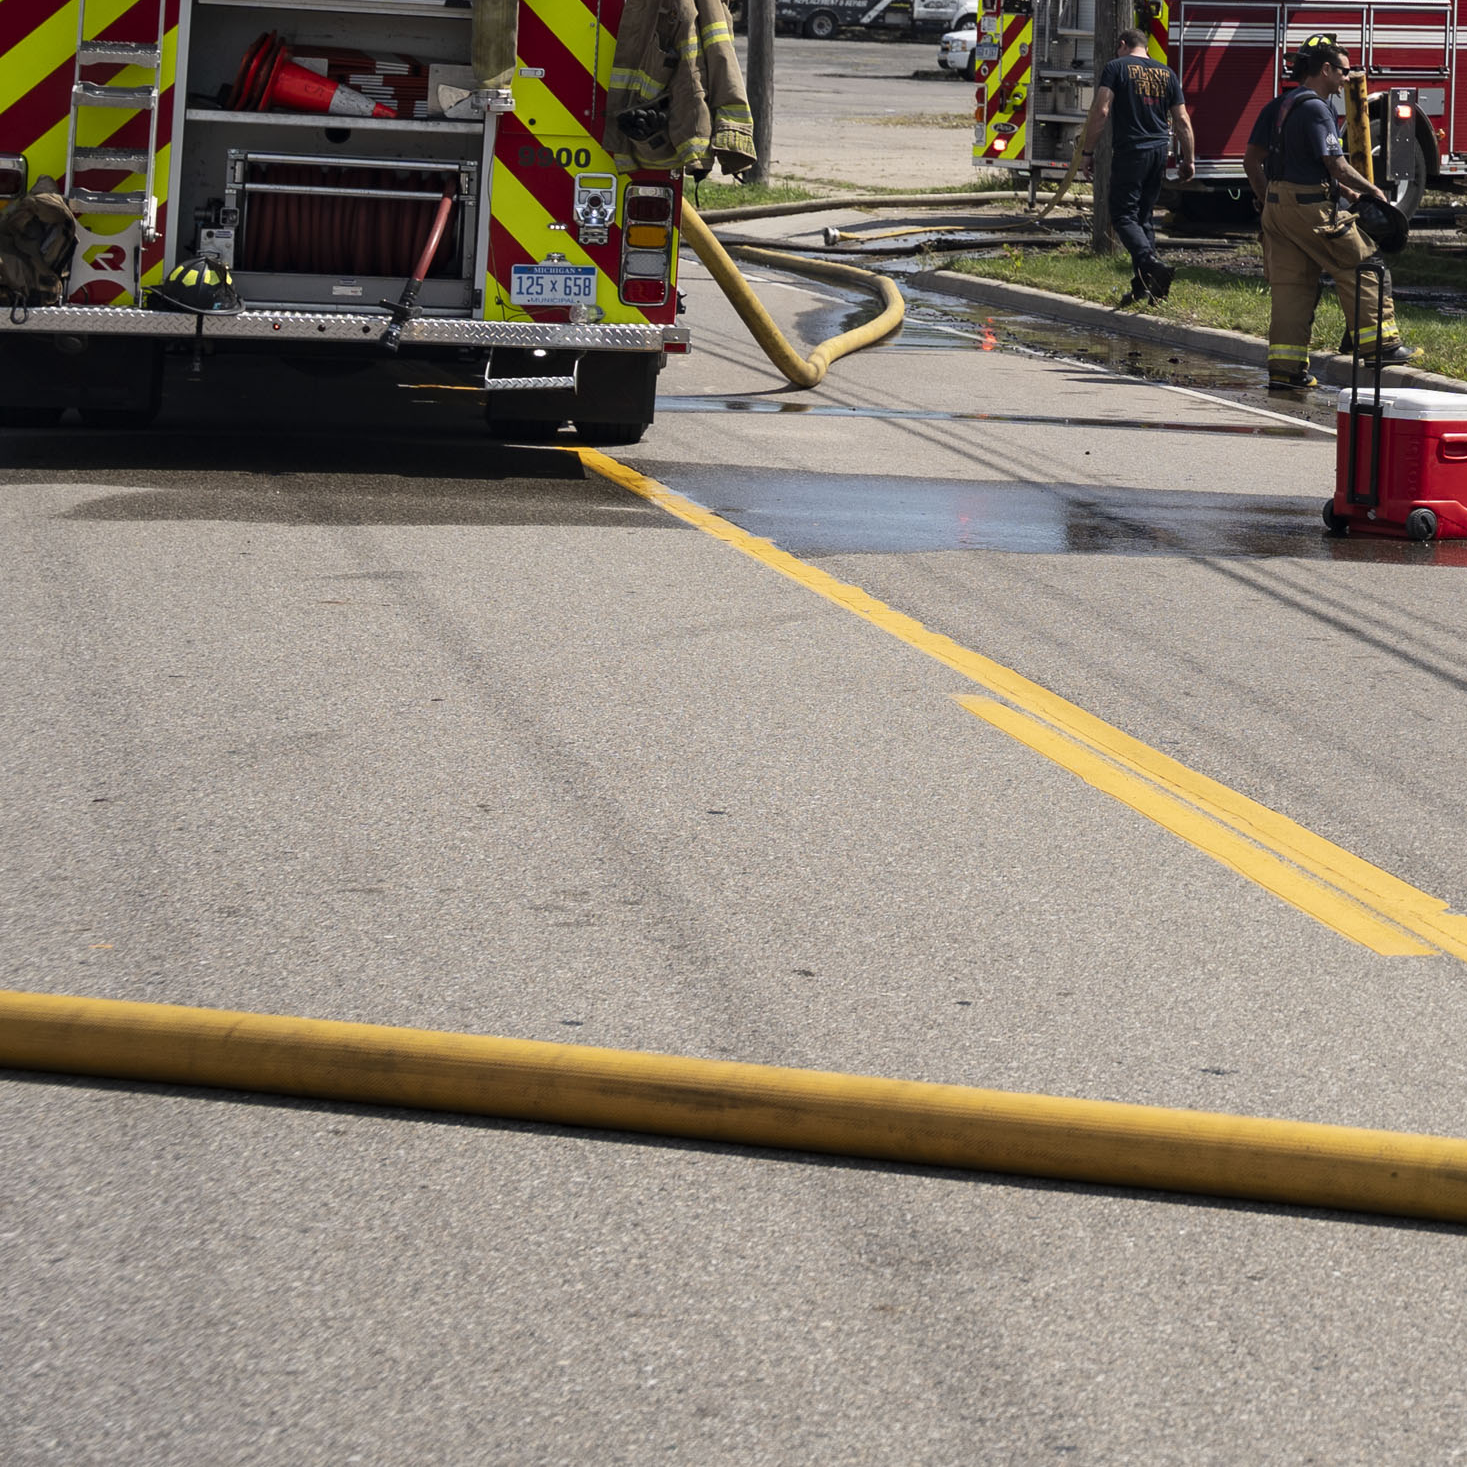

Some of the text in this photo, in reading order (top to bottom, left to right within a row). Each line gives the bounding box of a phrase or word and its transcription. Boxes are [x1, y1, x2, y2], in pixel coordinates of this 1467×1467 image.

[518, 146, 591, 169] 9900
[533, 266, 576, 275] MICHIGAN
[515, 275, 544, 296] 125
[563, 276, 592, 297] 658
[530, 297, 576, 305] MUNICIPAL
